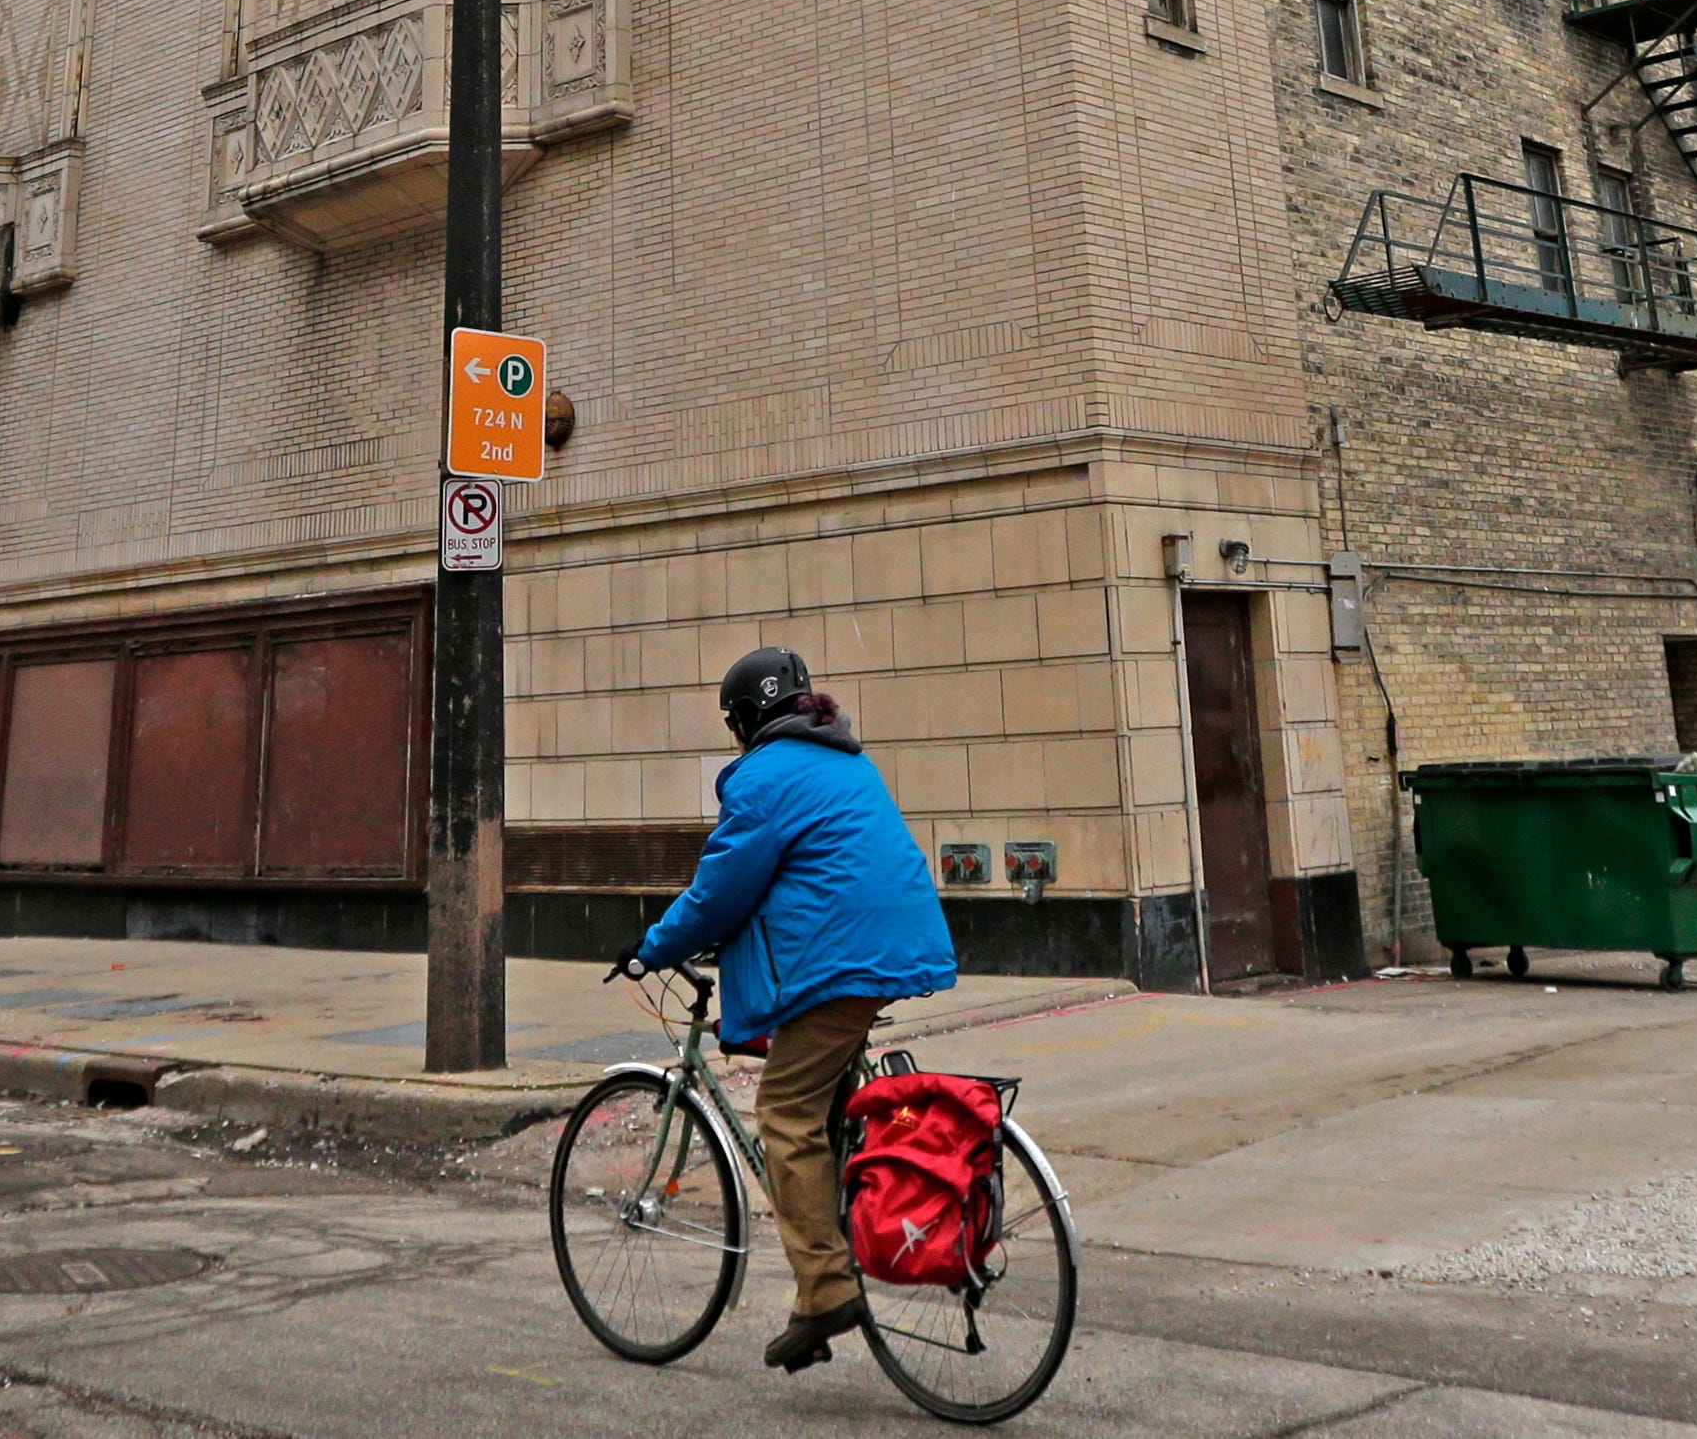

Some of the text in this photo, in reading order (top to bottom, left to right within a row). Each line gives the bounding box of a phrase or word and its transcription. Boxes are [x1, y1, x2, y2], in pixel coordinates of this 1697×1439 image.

[506, 360, 525, 391] P
[473, 407, 523, 430] 724 N
[480, 441, 513, 461] 2nd
[447, 537, 497, 550] BUS STOP
